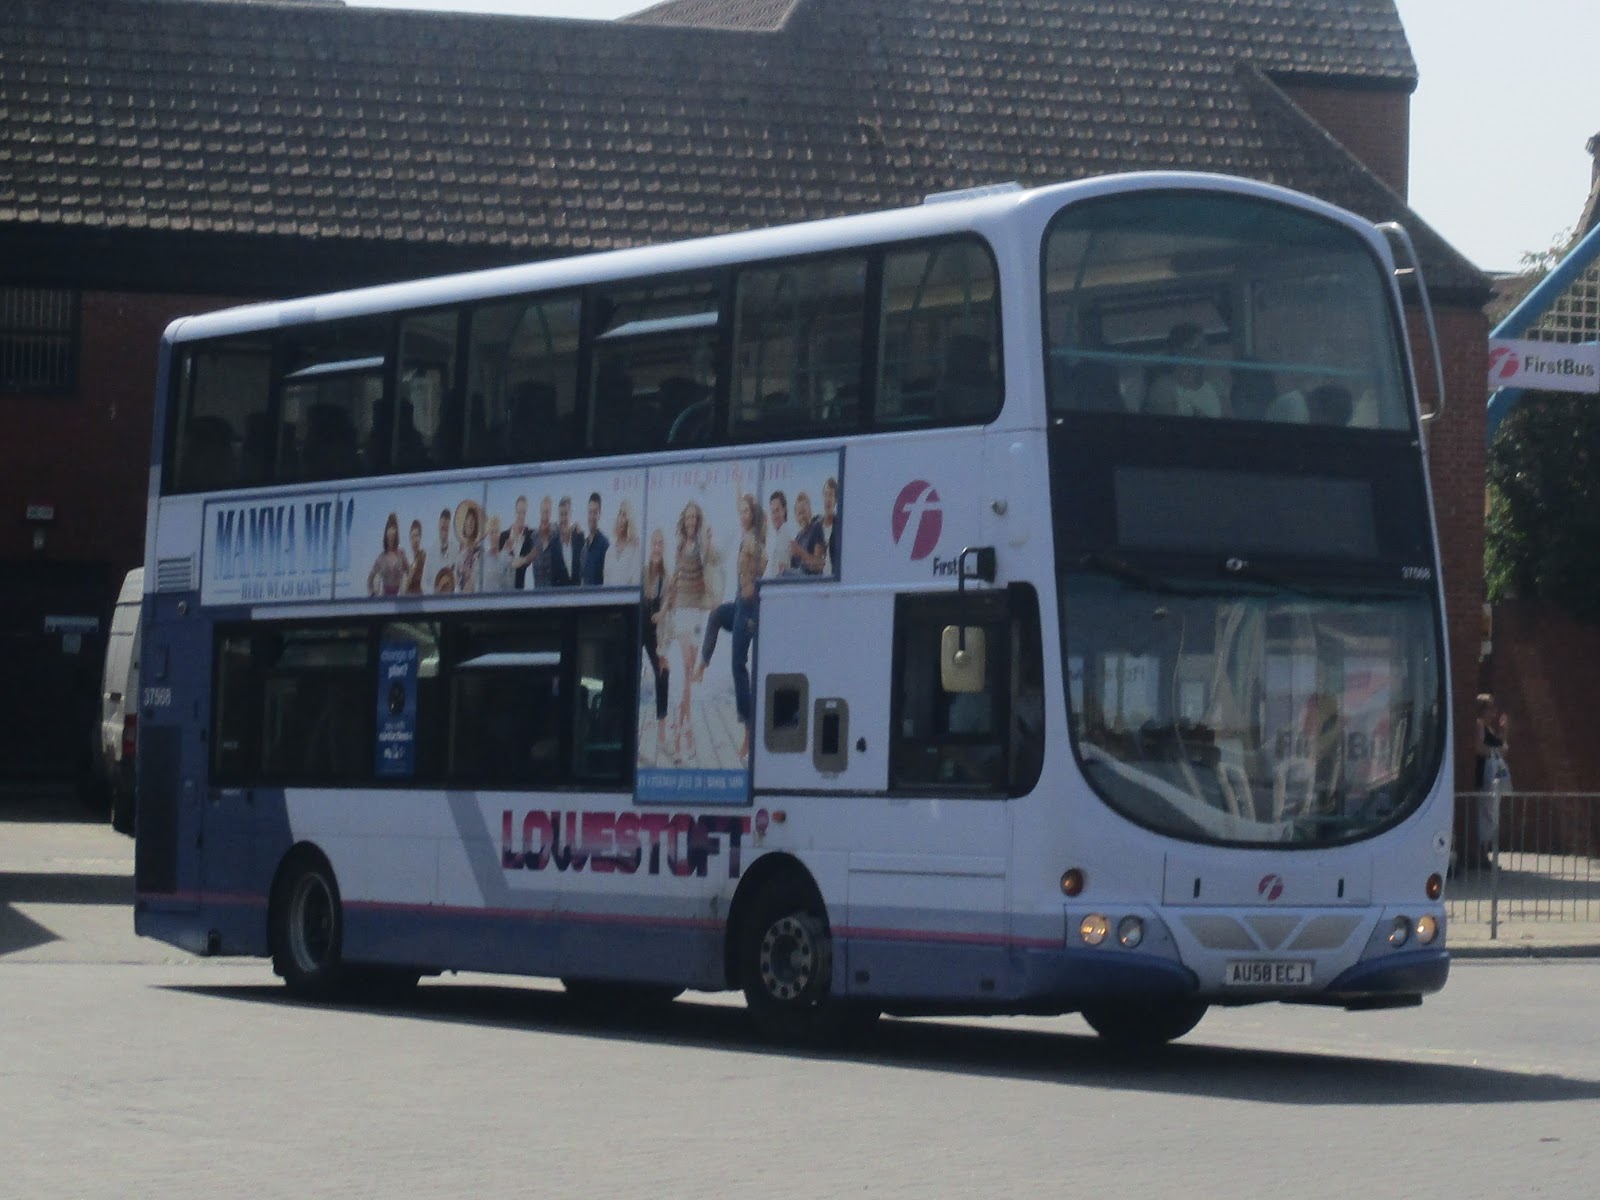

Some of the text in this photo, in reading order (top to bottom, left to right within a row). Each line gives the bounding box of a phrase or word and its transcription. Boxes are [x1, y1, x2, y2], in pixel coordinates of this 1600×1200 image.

[1524, 356, 1595, 377] FirstBus
[932, 557, 957, 576] First
[502, 809, 751, 879] LOWESTOFT
[1233, 964, 1305, 982] AU58 ECJ
